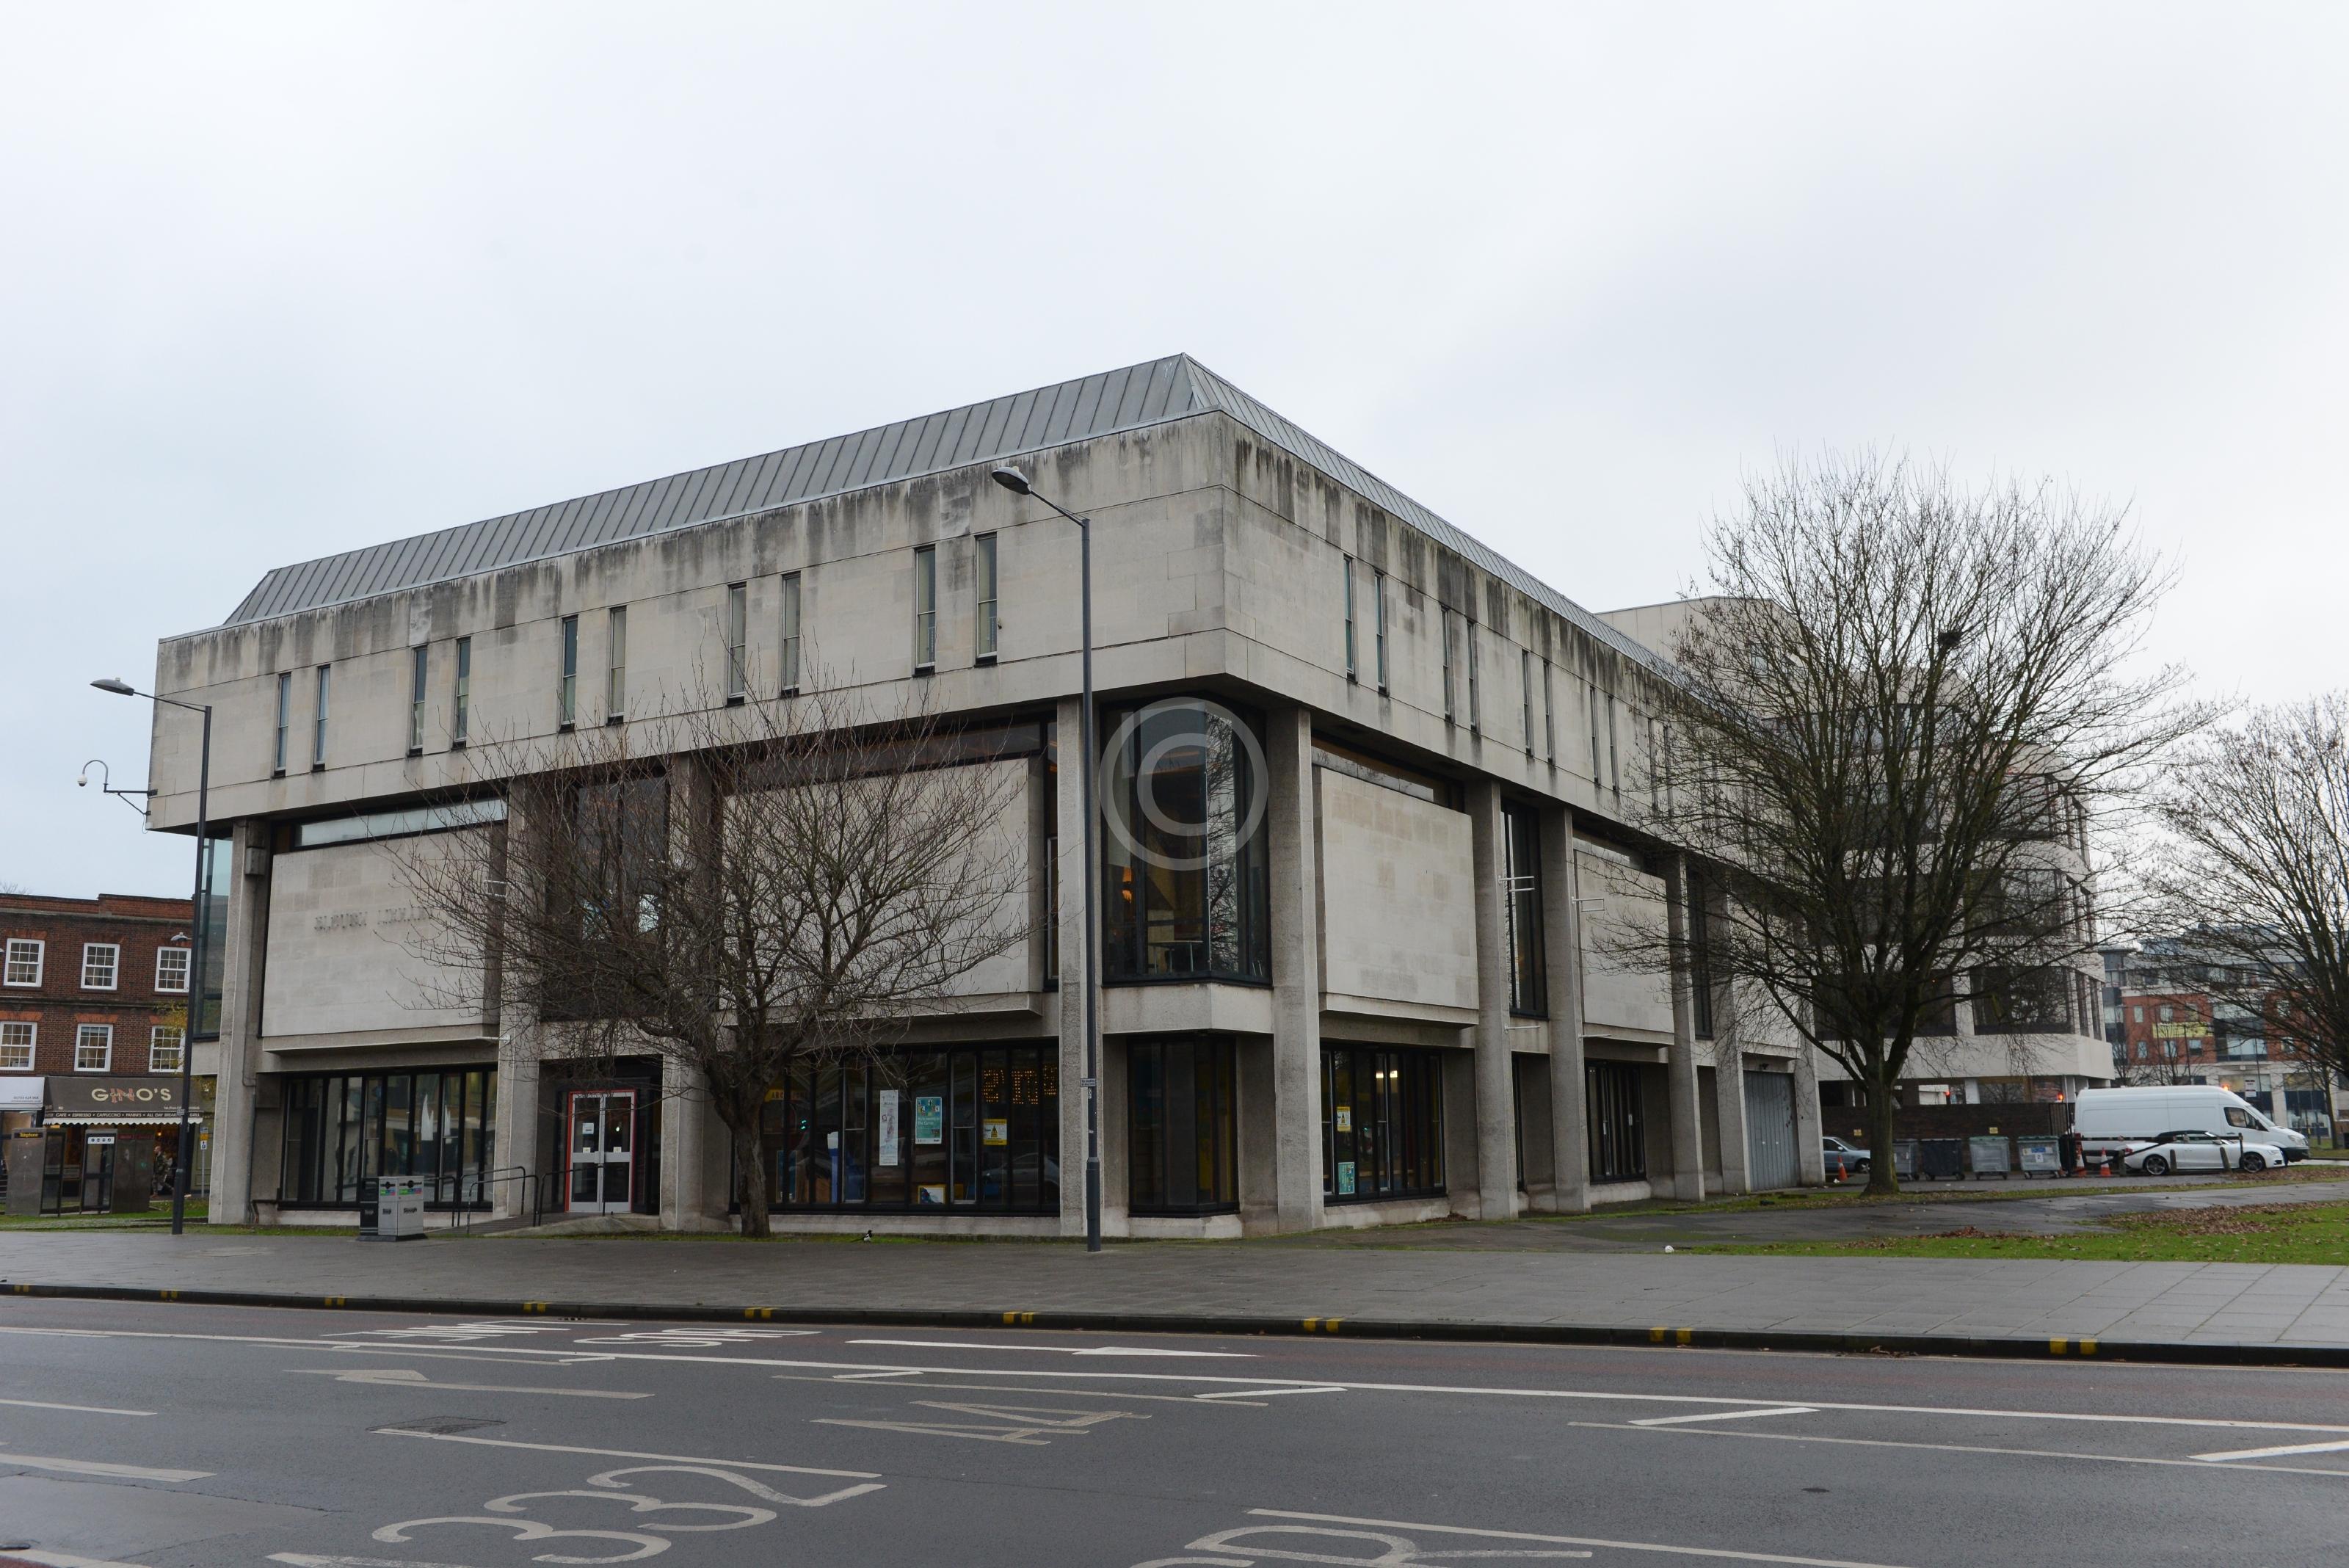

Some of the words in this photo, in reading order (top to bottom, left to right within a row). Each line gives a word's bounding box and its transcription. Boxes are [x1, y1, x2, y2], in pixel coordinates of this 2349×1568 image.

[91, 1088, 172, 1103] GINO'S
[319, 1319, 631, 1343] LANE
[573, 1327, 823, 1348] BUS
[809, 1400, 1152, 1445] A4
